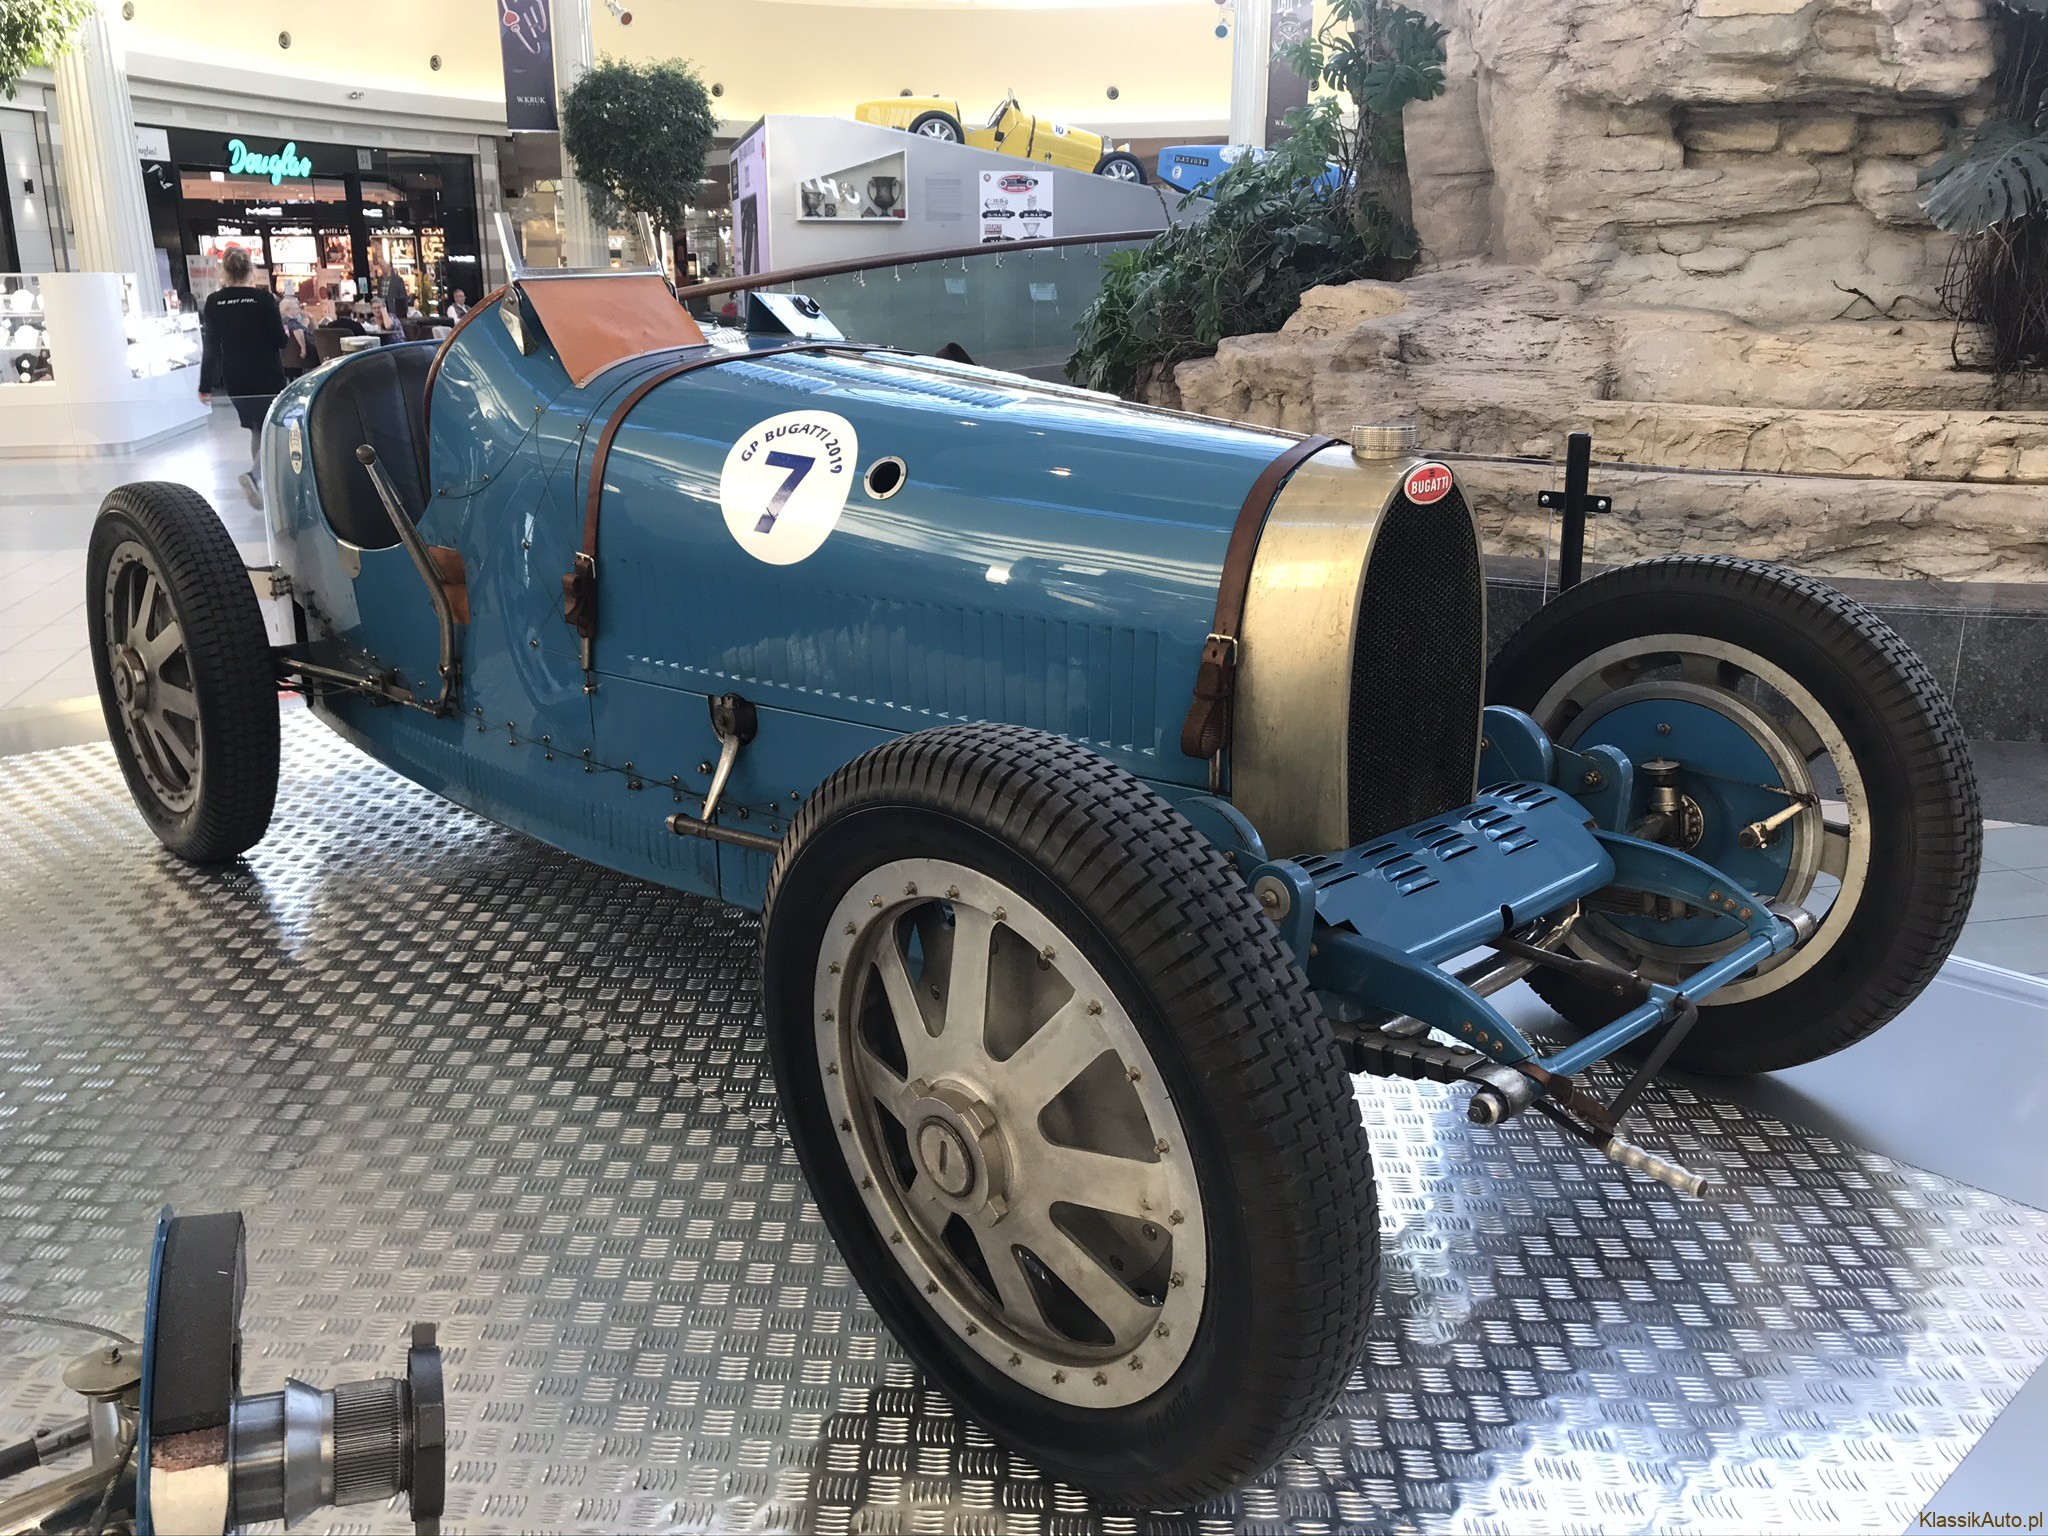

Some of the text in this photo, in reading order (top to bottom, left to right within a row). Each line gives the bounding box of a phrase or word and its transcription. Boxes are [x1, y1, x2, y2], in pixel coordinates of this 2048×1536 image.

[1055, 125, 1064, 135] 10
[228, 138, 312, 186] Douglas
[741, 423, 843, 474] GP BUGATTI 2019
[753, 450, 816, 534] 7
[1411, 476, 1449, 495] BUGATTI
